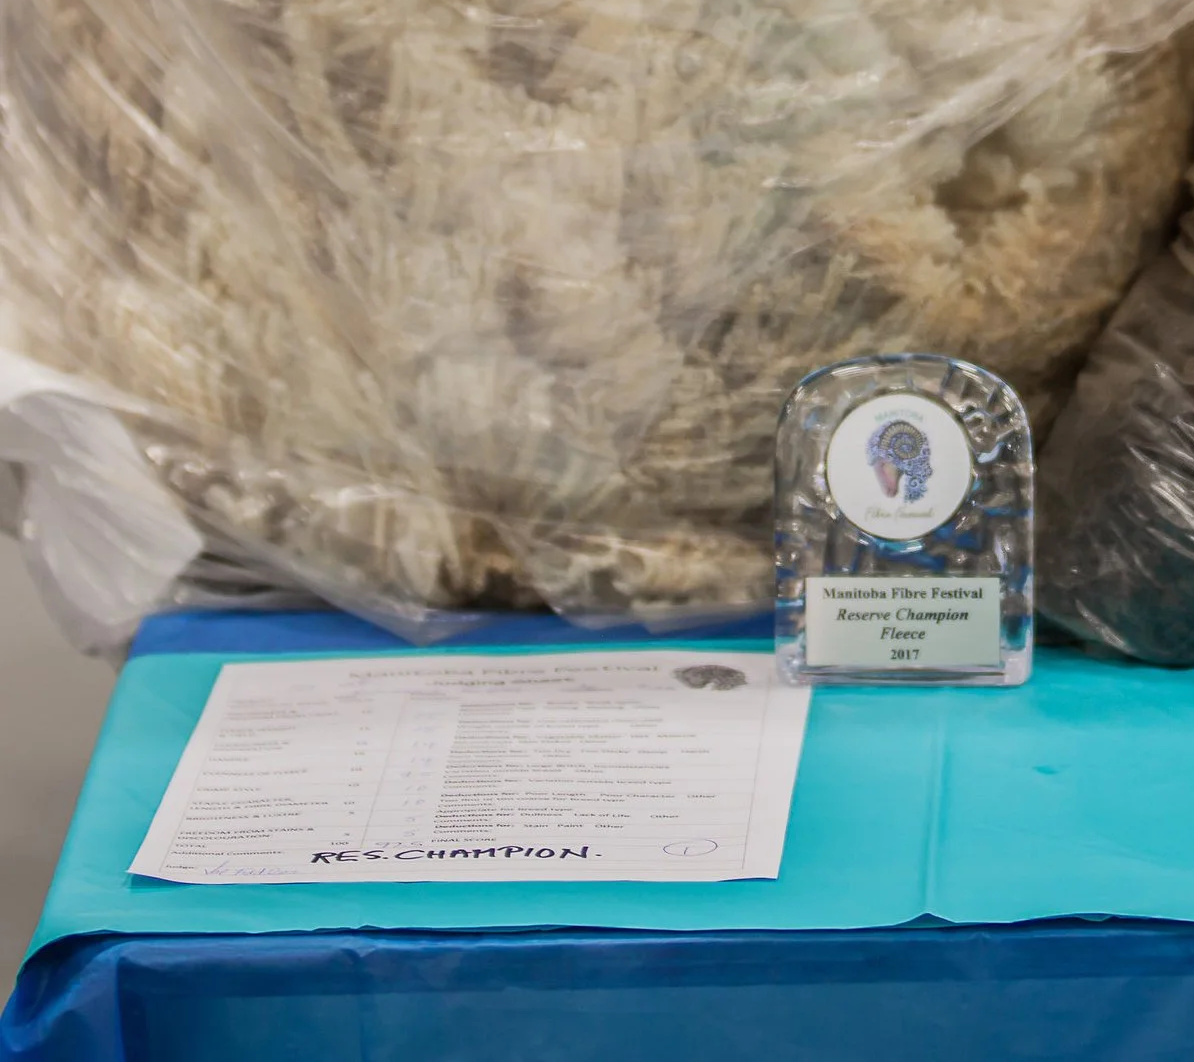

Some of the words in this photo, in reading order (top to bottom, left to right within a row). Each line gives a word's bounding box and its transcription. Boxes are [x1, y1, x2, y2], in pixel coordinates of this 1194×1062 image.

[823, 587, 887, 600] Manitoba
[891, 587, 927, 600] Fibre
[931, 587, 983, 600] Festival
[836, 608, 890, 622] Reserve
[895, 608, 969, 623] Champion
[880, 627, 926, 640] Fleece
[890, 649, 920, 660] 2017
